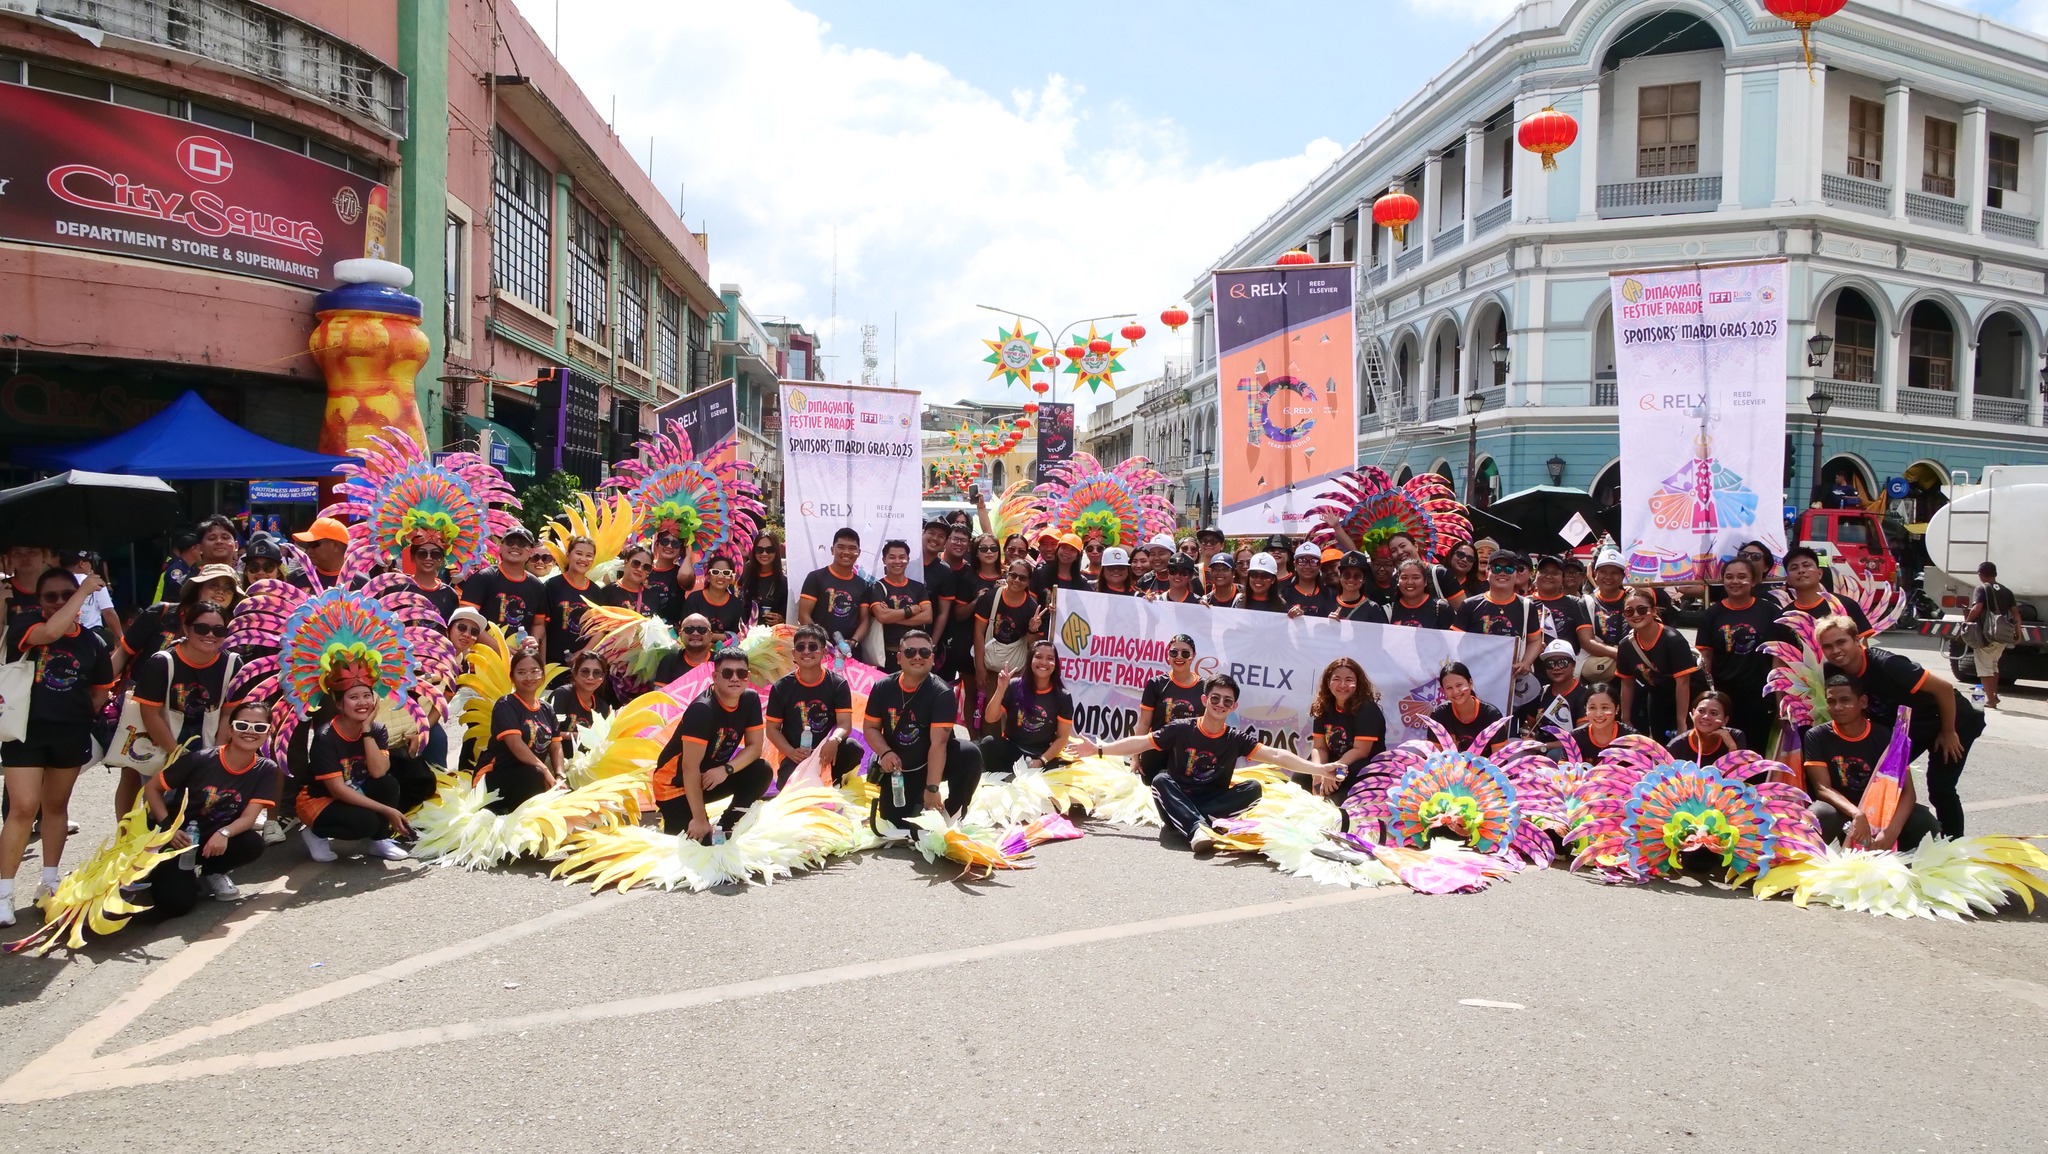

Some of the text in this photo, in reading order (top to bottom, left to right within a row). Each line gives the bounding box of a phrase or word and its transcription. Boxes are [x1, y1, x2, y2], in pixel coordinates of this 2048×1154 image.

[185, 191, 324, 256] Square
[56, 220, 319, 280] DEPARTMENT STORE & SUPERMARKET
[1251, 282, 1288, 298] RELX
[1645, 283, 1732, 304] DINAGYANG IFFI
[1623, 301, 1703, 319] FESTIVE PARADE
[1681, 323, 1717, 340] MARDI
[1719, 321, 1747, 337] GRAS
[1750, 320, 1777, 337] 2025
[808, 400, 855, 416] DINAGYANG
[1663, 393, 1707, 409] RELX
[678, 410, 698, 430] RELX
[789, 415, 822, 430] FESTIVE
[824, 417, 855, 431] PARADE
[861, 412, 878, 424] IFFI
[835, 440, 865, 455] MARDI
[868, 441, 890, 457] GRAS
[891, 443, 913, 458] 2025
[1267, 441, 1284, 450] YEARS
[1292, 436, 1311, 449] ILOILO
[820, 504, 853, 517] RELX
[1060, 658, 1164, 689] FESTIVE PARA
[1230, 662, 1294, 690] RELX
[1074, 702, 1138, 740] ONSOR
